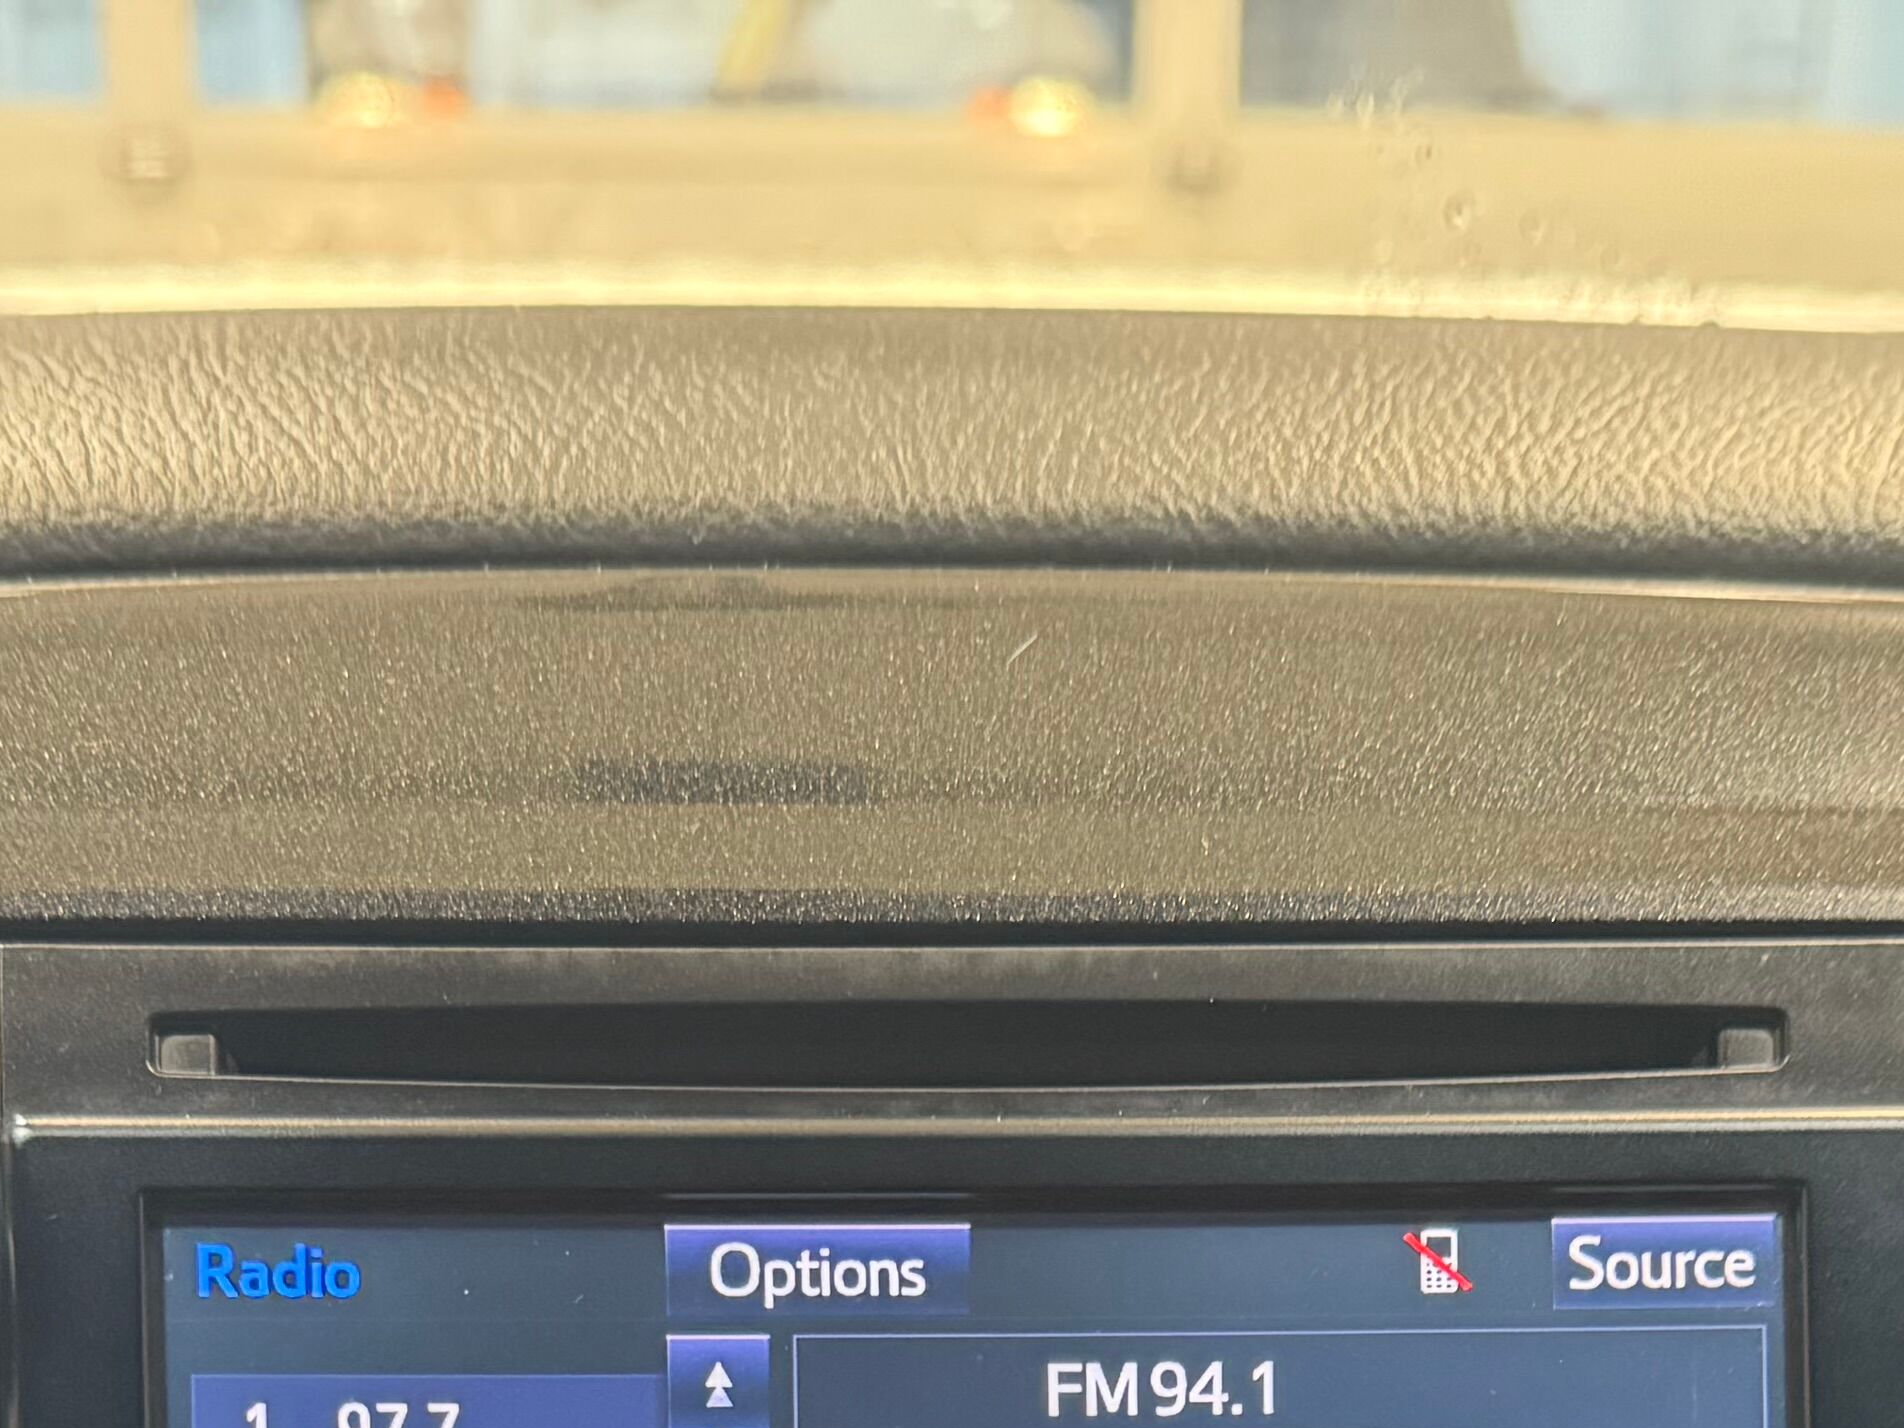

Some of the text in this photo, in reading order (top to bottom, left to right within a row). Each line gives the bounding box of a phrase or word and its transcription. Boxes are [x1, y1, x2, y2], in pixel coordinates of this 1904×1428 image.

[195, 1242, 361, 1299] Radio
[709, 1242, 927, 1309] Options
[1566, 1235, 1757, 1290] Source
